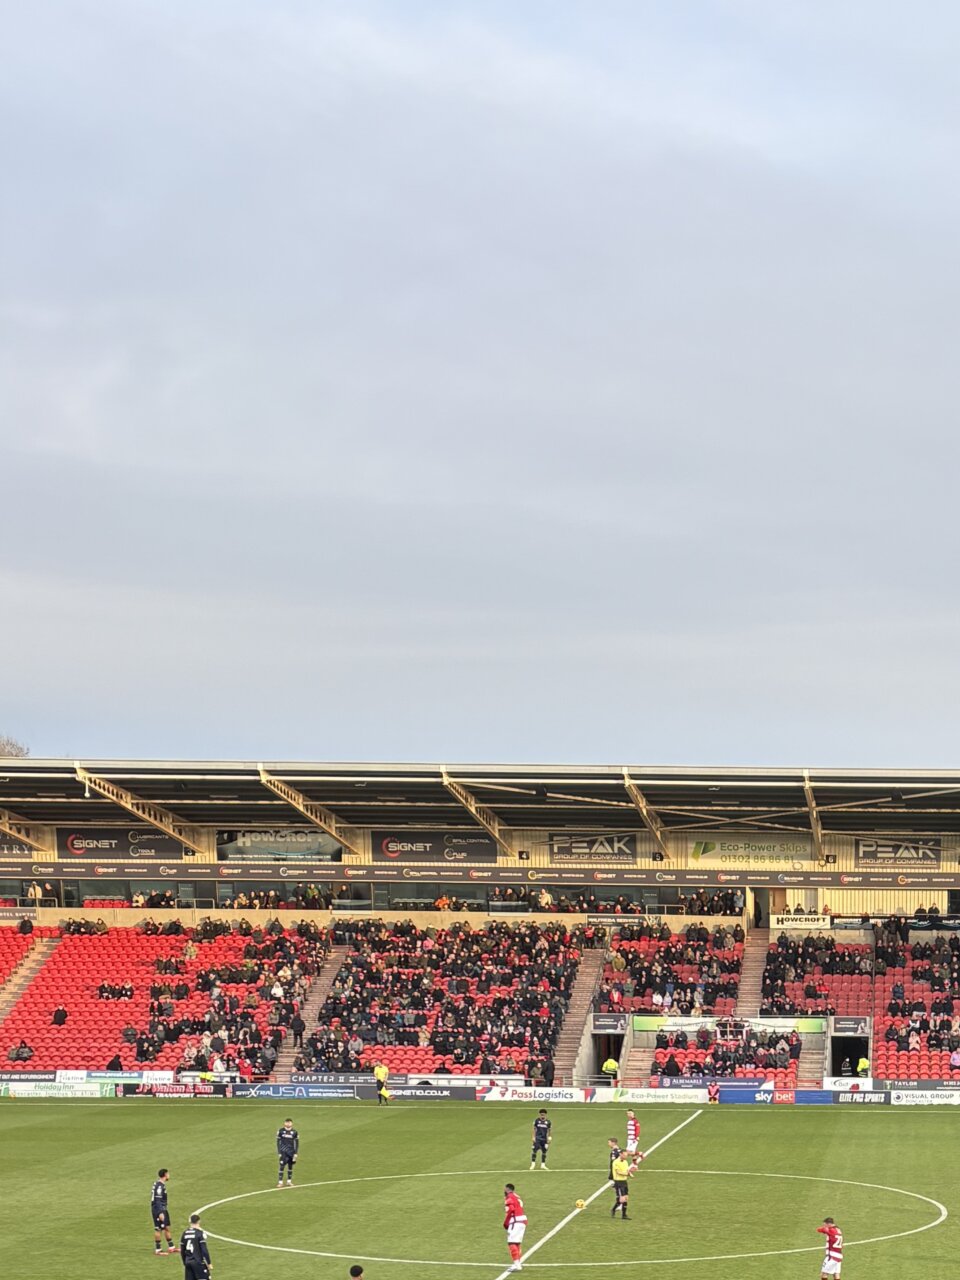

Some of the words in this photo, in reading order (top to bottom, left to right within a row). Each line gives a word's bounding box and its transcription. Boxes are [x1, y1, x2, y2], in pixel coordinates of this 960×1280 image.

[73, 839, 118, 849] SIGNET
[388, 842, 432, 852] SIGNET
[553, 836, 632, 854] PEAK
[720, 842, 777, 852] Eco-Power
[779, 842, 807, 855] Skips
[859, 841, 936, 858] PEAK
[720, 854, 750, 865] 01302
[754, 855, 769, 864] 86
[776, 916, 827, 925] HOWCROFT
[292, 1075, 335, 1083] CHAPTER
[34, 1083, 62, 1091] Holiday
[62, 1083, 75, 1091] Inn
[271, 1086, 307, 1098] USA
[510, 1088, 574, 1101] PassLogistics
[631, 1091, 669, 1100] Eco-Power
[669, 1091, 699, 1100] Stadium
[754, 1090, 773, 1103] sky
[774, 1091, 793, 1101] bet
[186, 1239, 194, 1253] 4
